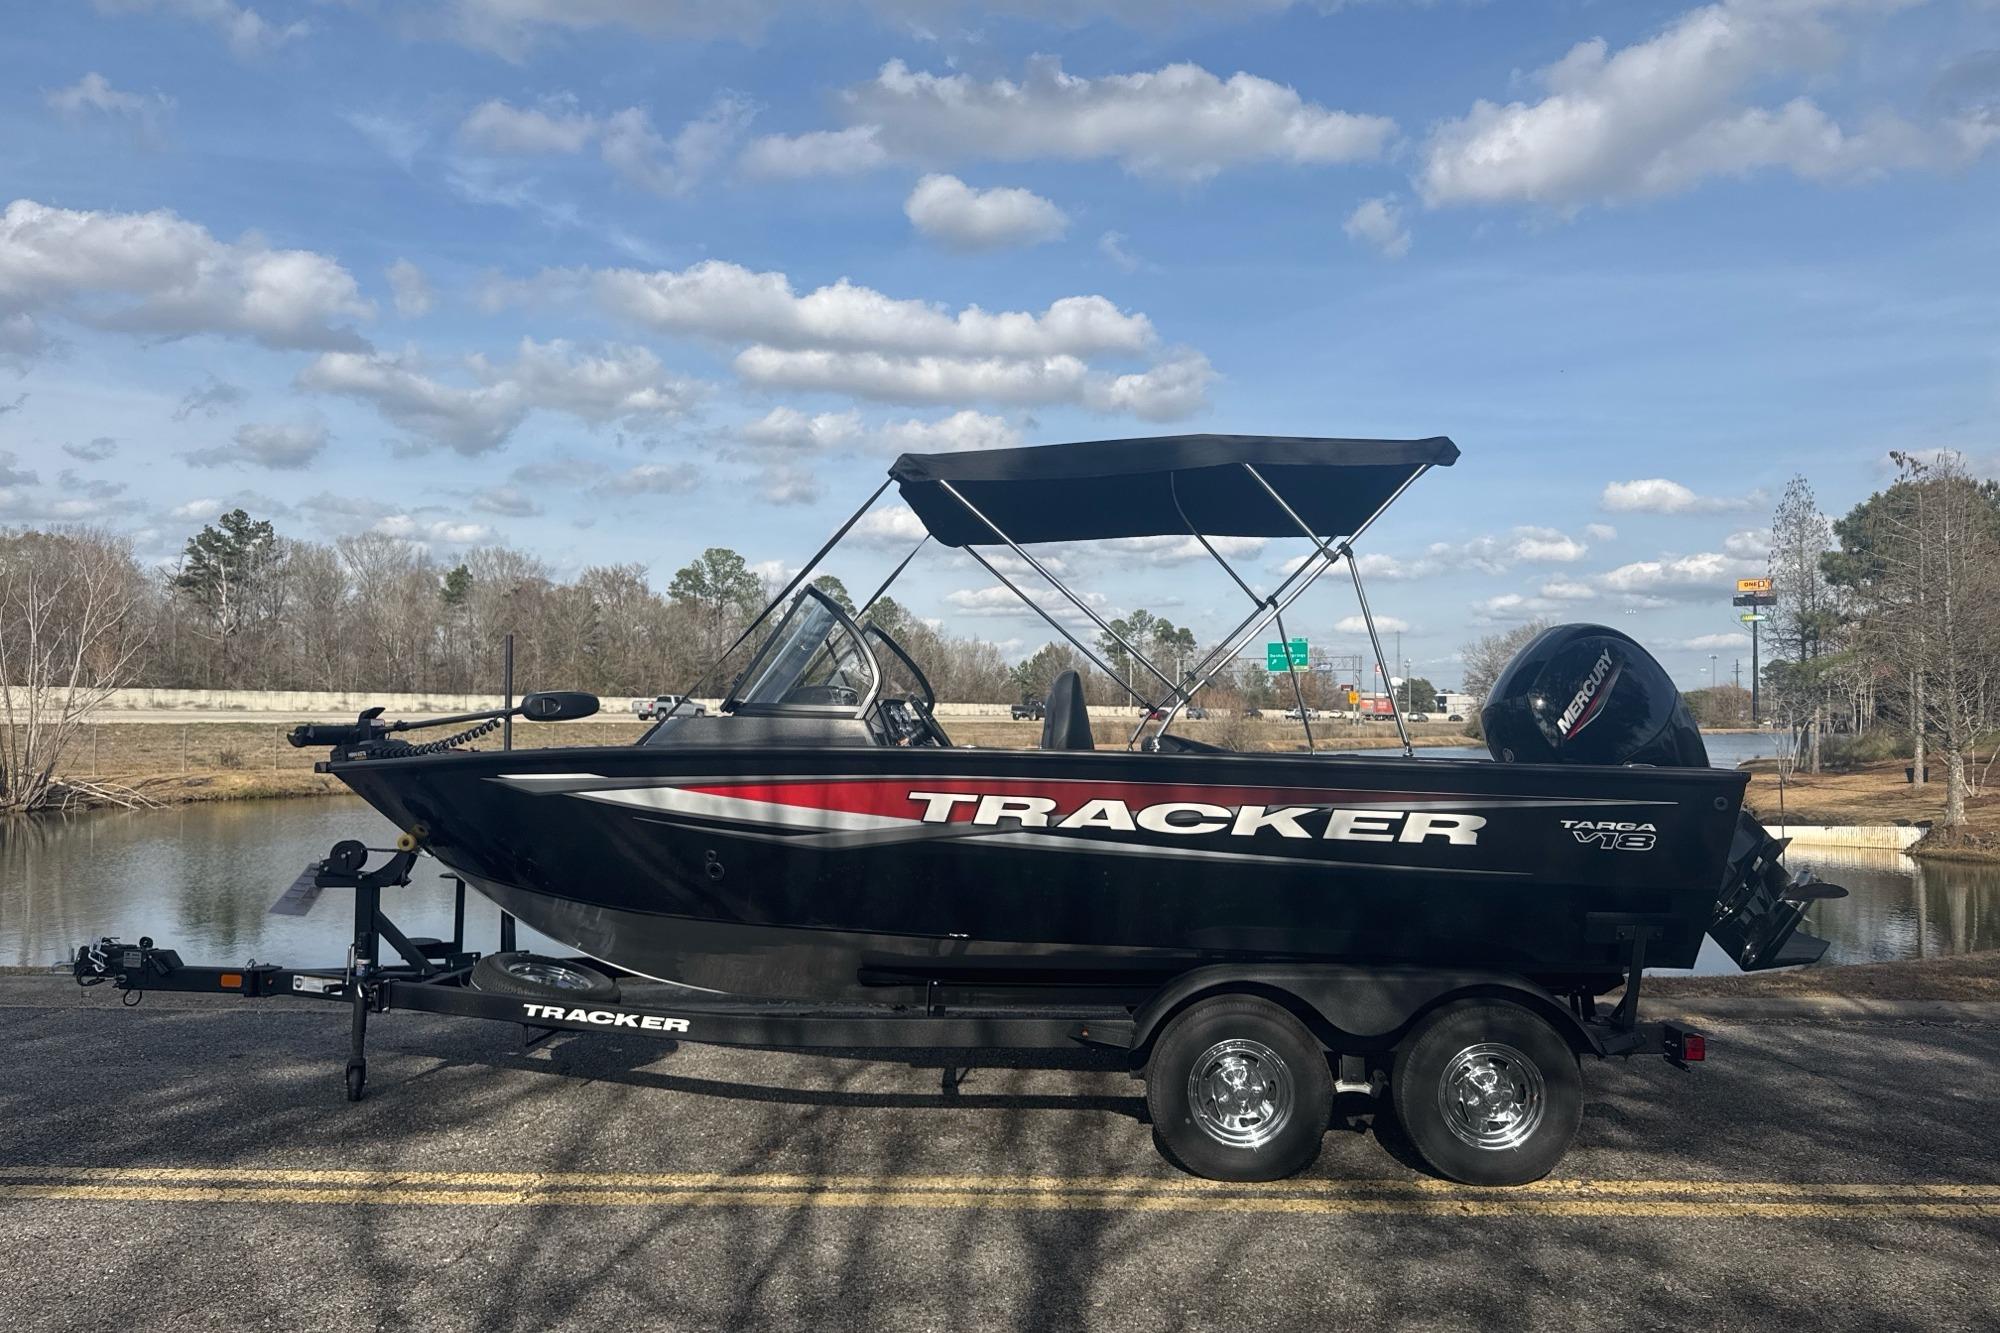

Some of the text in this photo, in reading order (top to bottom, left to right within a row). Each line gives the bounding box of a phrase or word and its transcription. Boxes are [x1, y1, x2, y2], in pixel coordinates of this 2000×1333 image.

[1557, 648, 1612, 734] MERCURY
[908, 791, 1487, 846] TRACKER
[1560, 820, 1656, 832] TARGA
[1572, 831, 1656, 851] V18
[523, 1003, 691, 1033] TRACKER
